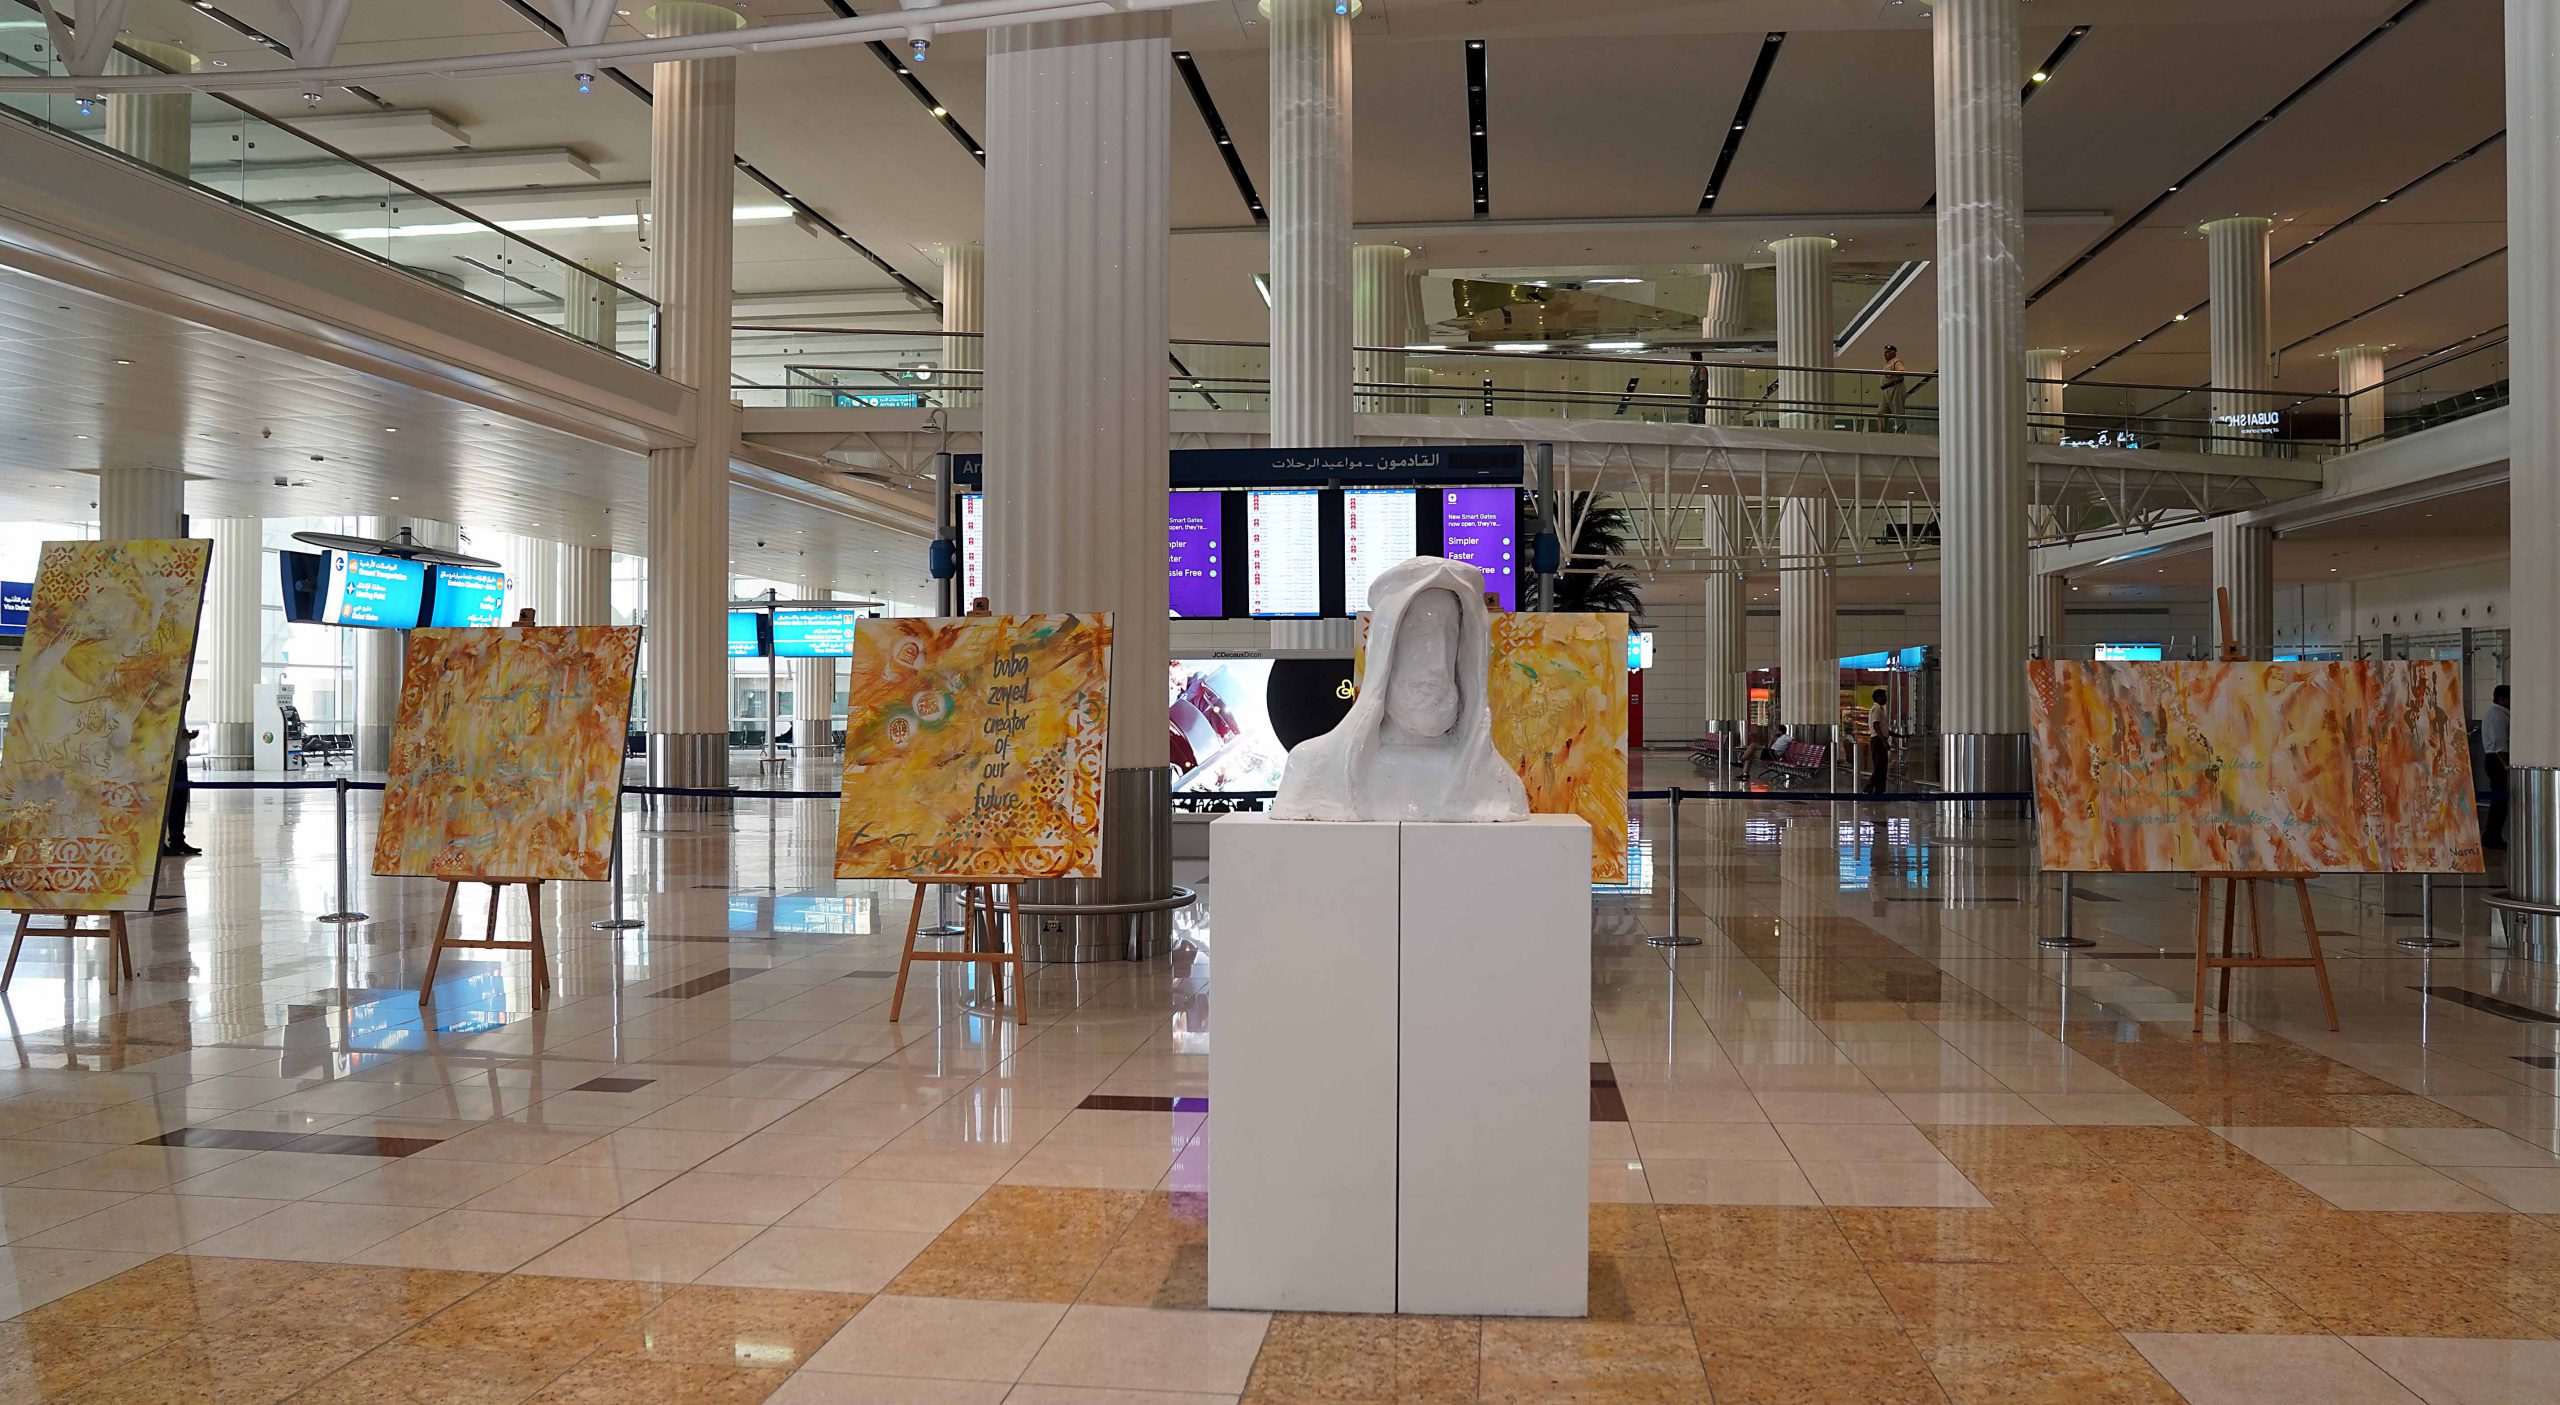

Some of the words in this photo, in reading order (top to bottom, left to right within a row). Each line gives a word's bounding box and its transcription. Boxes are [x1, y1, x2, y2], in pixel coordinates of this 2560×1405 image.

[1272, 457, 1320, 471] الرحلات
[1321, 457, 1363, 471] مواعيد
[1377, 453, 1440, 471] القادمون
[1448, 537, 1479, 546] Simpler
[1448, 552, 1475, 560] Faster
[1184, 569, 1202, 577] Free
[993, 650, 1029, 679] baba
[987, 677, 1029, 716] zayed
[983, 709, 1030, 738] creator
[994, 735, 1011, 761] of
[983, 761, 1010, 779] our
[974, 783, 1024, 819] future
